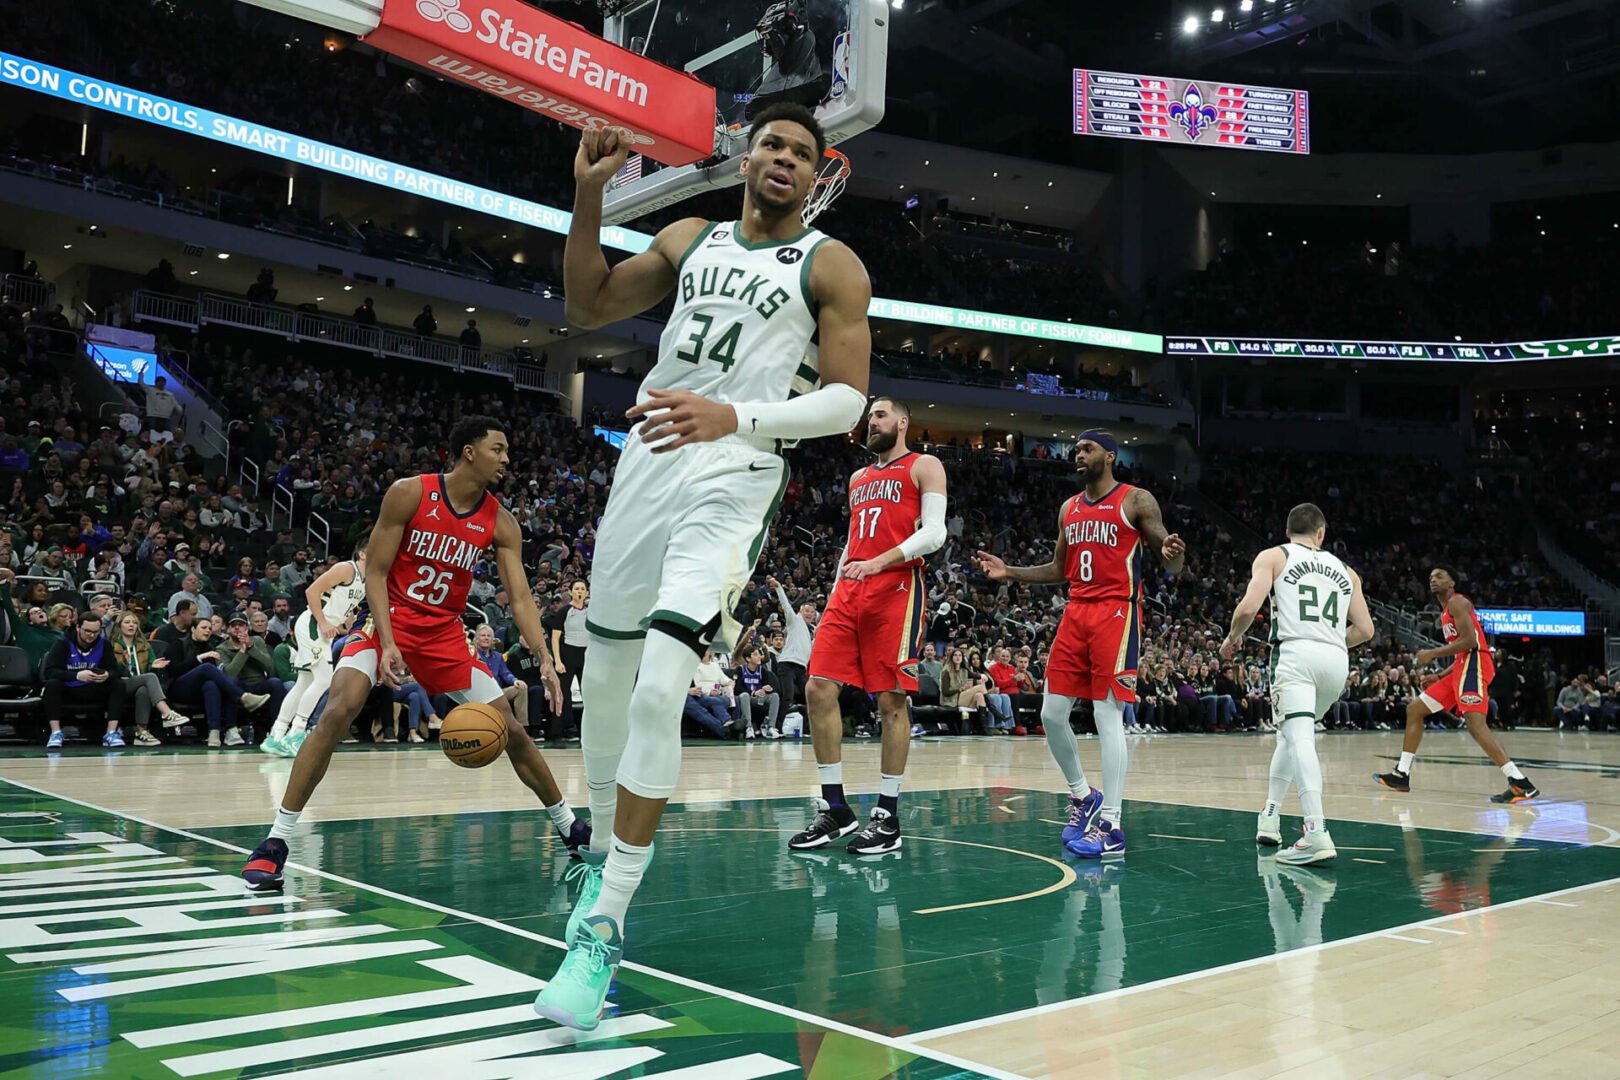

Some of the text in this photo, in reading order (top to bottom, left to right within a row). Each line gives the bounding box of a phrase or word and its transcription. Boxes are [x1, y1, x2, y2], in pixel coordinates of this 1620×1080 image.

[0, 57, 565, 229] SON CONTROLS. SMART BUILDING PARTNER OF FISERV
[682, 267, 791, 320] BUCKS
[891, 303, 954, 323] BUILDING
[957, 312, 1017, 332] PARTNER
[1020, 320, 1038, 333] OF
[1041, 325, 1085, 339] FISERV
[1087, 329, 1133, 346] FORUM
[676, 312, 743, 373] 34
[1214, 341, 1230, 351] FG
[1274, 343, 1297, 353] 3PT
[1341, 344, 1356, 354] FT
[1457, 347, 1480, 357] TOL
[850, 479, 902, 506] PELICANS
[859, 507, 882, 539] 17
[407, 529, 483, 572] PELICANS
[1080, 550, 1093, 582] 8
[407, 565, 453, 605] 25
[1283, 561, 1352, 595] CONNAUGHTON
[1298, 584, 1339, 628] 24
[1511, 613, 1533, 622] SAFE
[1536, 624, 1582, 633] BUILDINGS
[441, 738, 481, 750] Wilson
